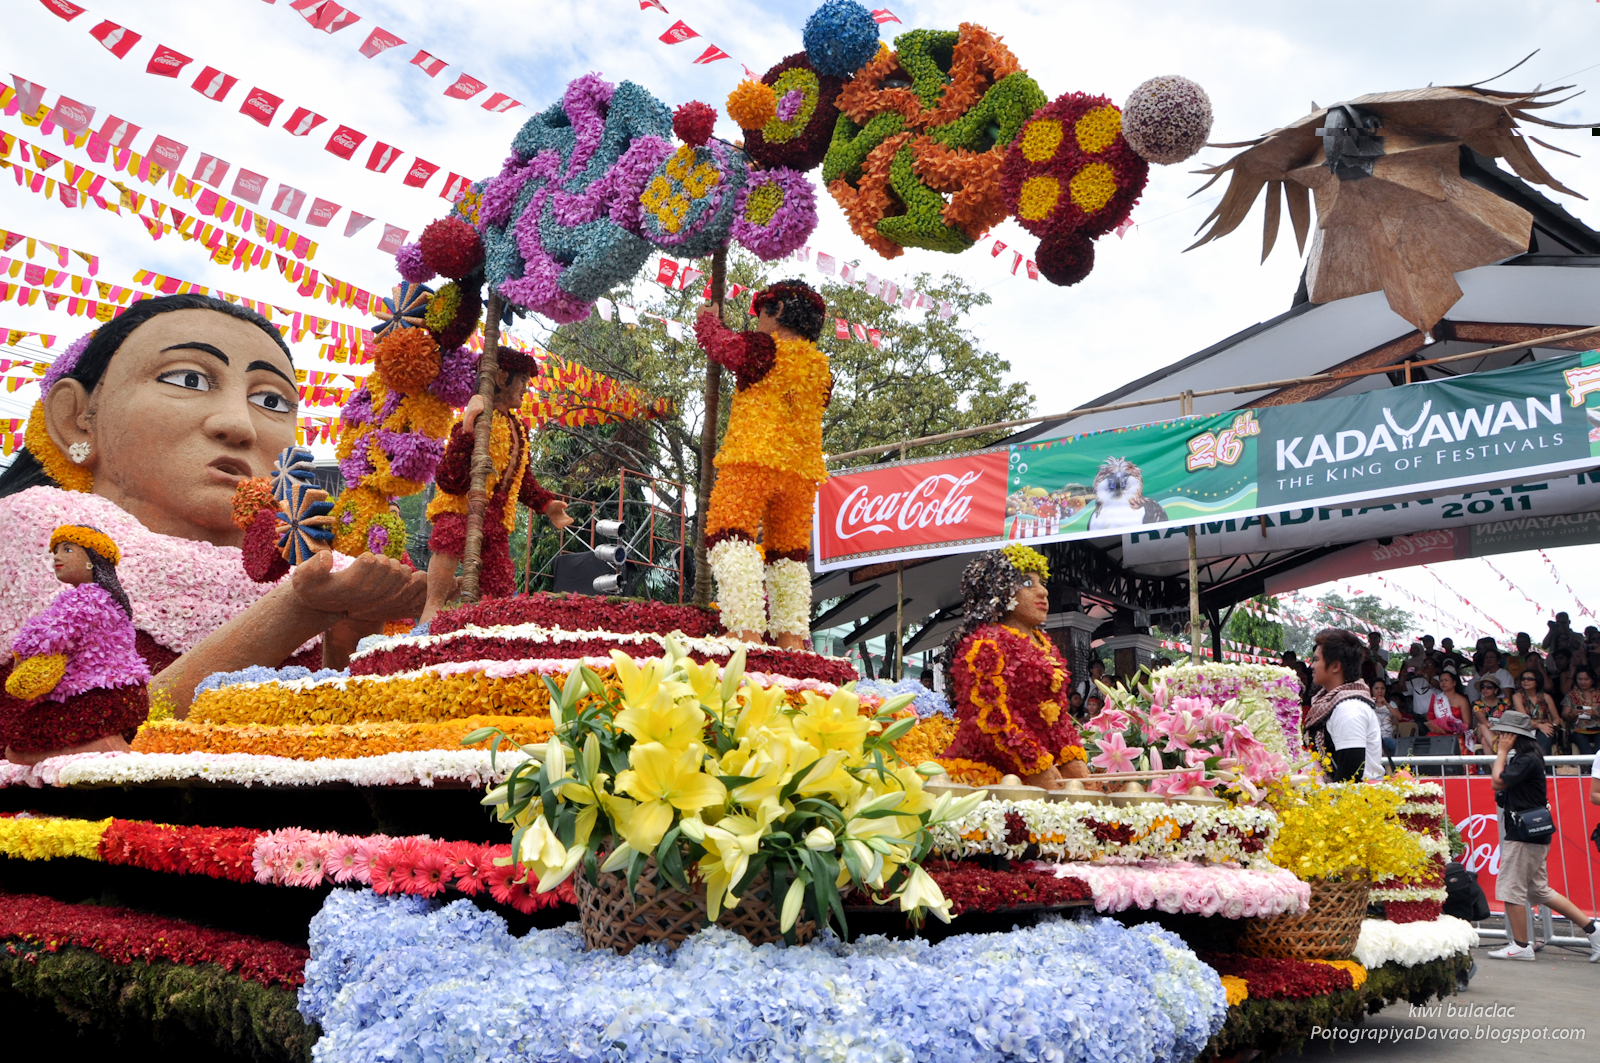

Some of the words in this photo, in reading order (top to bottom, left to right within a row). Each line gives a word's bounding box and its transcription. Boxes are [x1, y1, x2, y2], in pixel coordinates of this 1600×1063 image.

[154, 56, 183, 67] Coca-Cola
[247, 97, 275, 115] Coca-Cola
[333, 134, 357, 150] Coca-Cola
[1186, 410, 1261, 473] 26th
[1276, 393, 1563, 471] KADAYAWAN
[1277, 474, 1314, 490] THE
[1326, 462, 1382, 482] KING
[1395, 455, 1422, 471] OF
[1436, 432, 1564, 465] FESTIVALS
[835, 468, 985, 540] Coca-Cola
[1441, 494, 1532, 519] 2011
